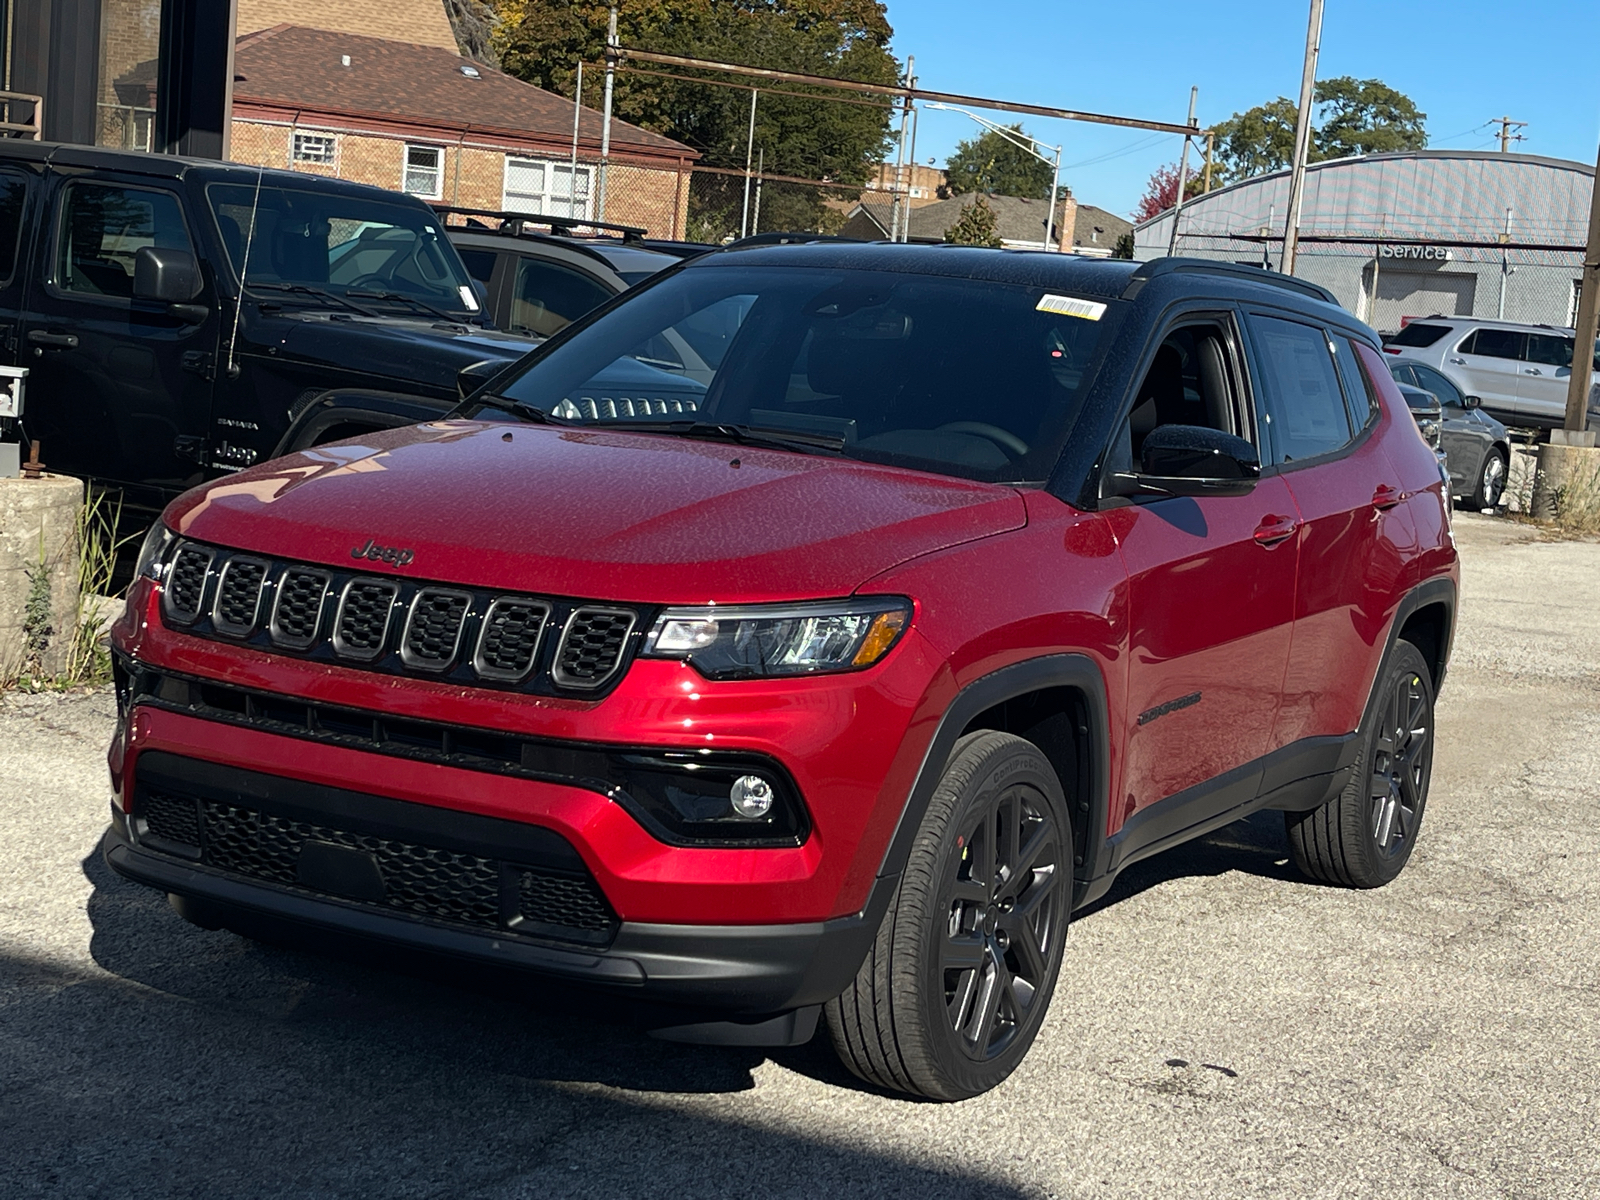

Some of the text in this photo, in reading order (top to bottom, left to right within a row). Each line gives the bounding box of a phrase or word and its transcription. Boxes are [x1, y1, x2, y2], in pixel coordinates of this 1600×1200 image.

[1382, 242, 1446, 260] Service
[217, 418, 258, 430] SAHARA
[215, 440, 258, 465] Jeep
[351, 539, 415, 568] Jeep
